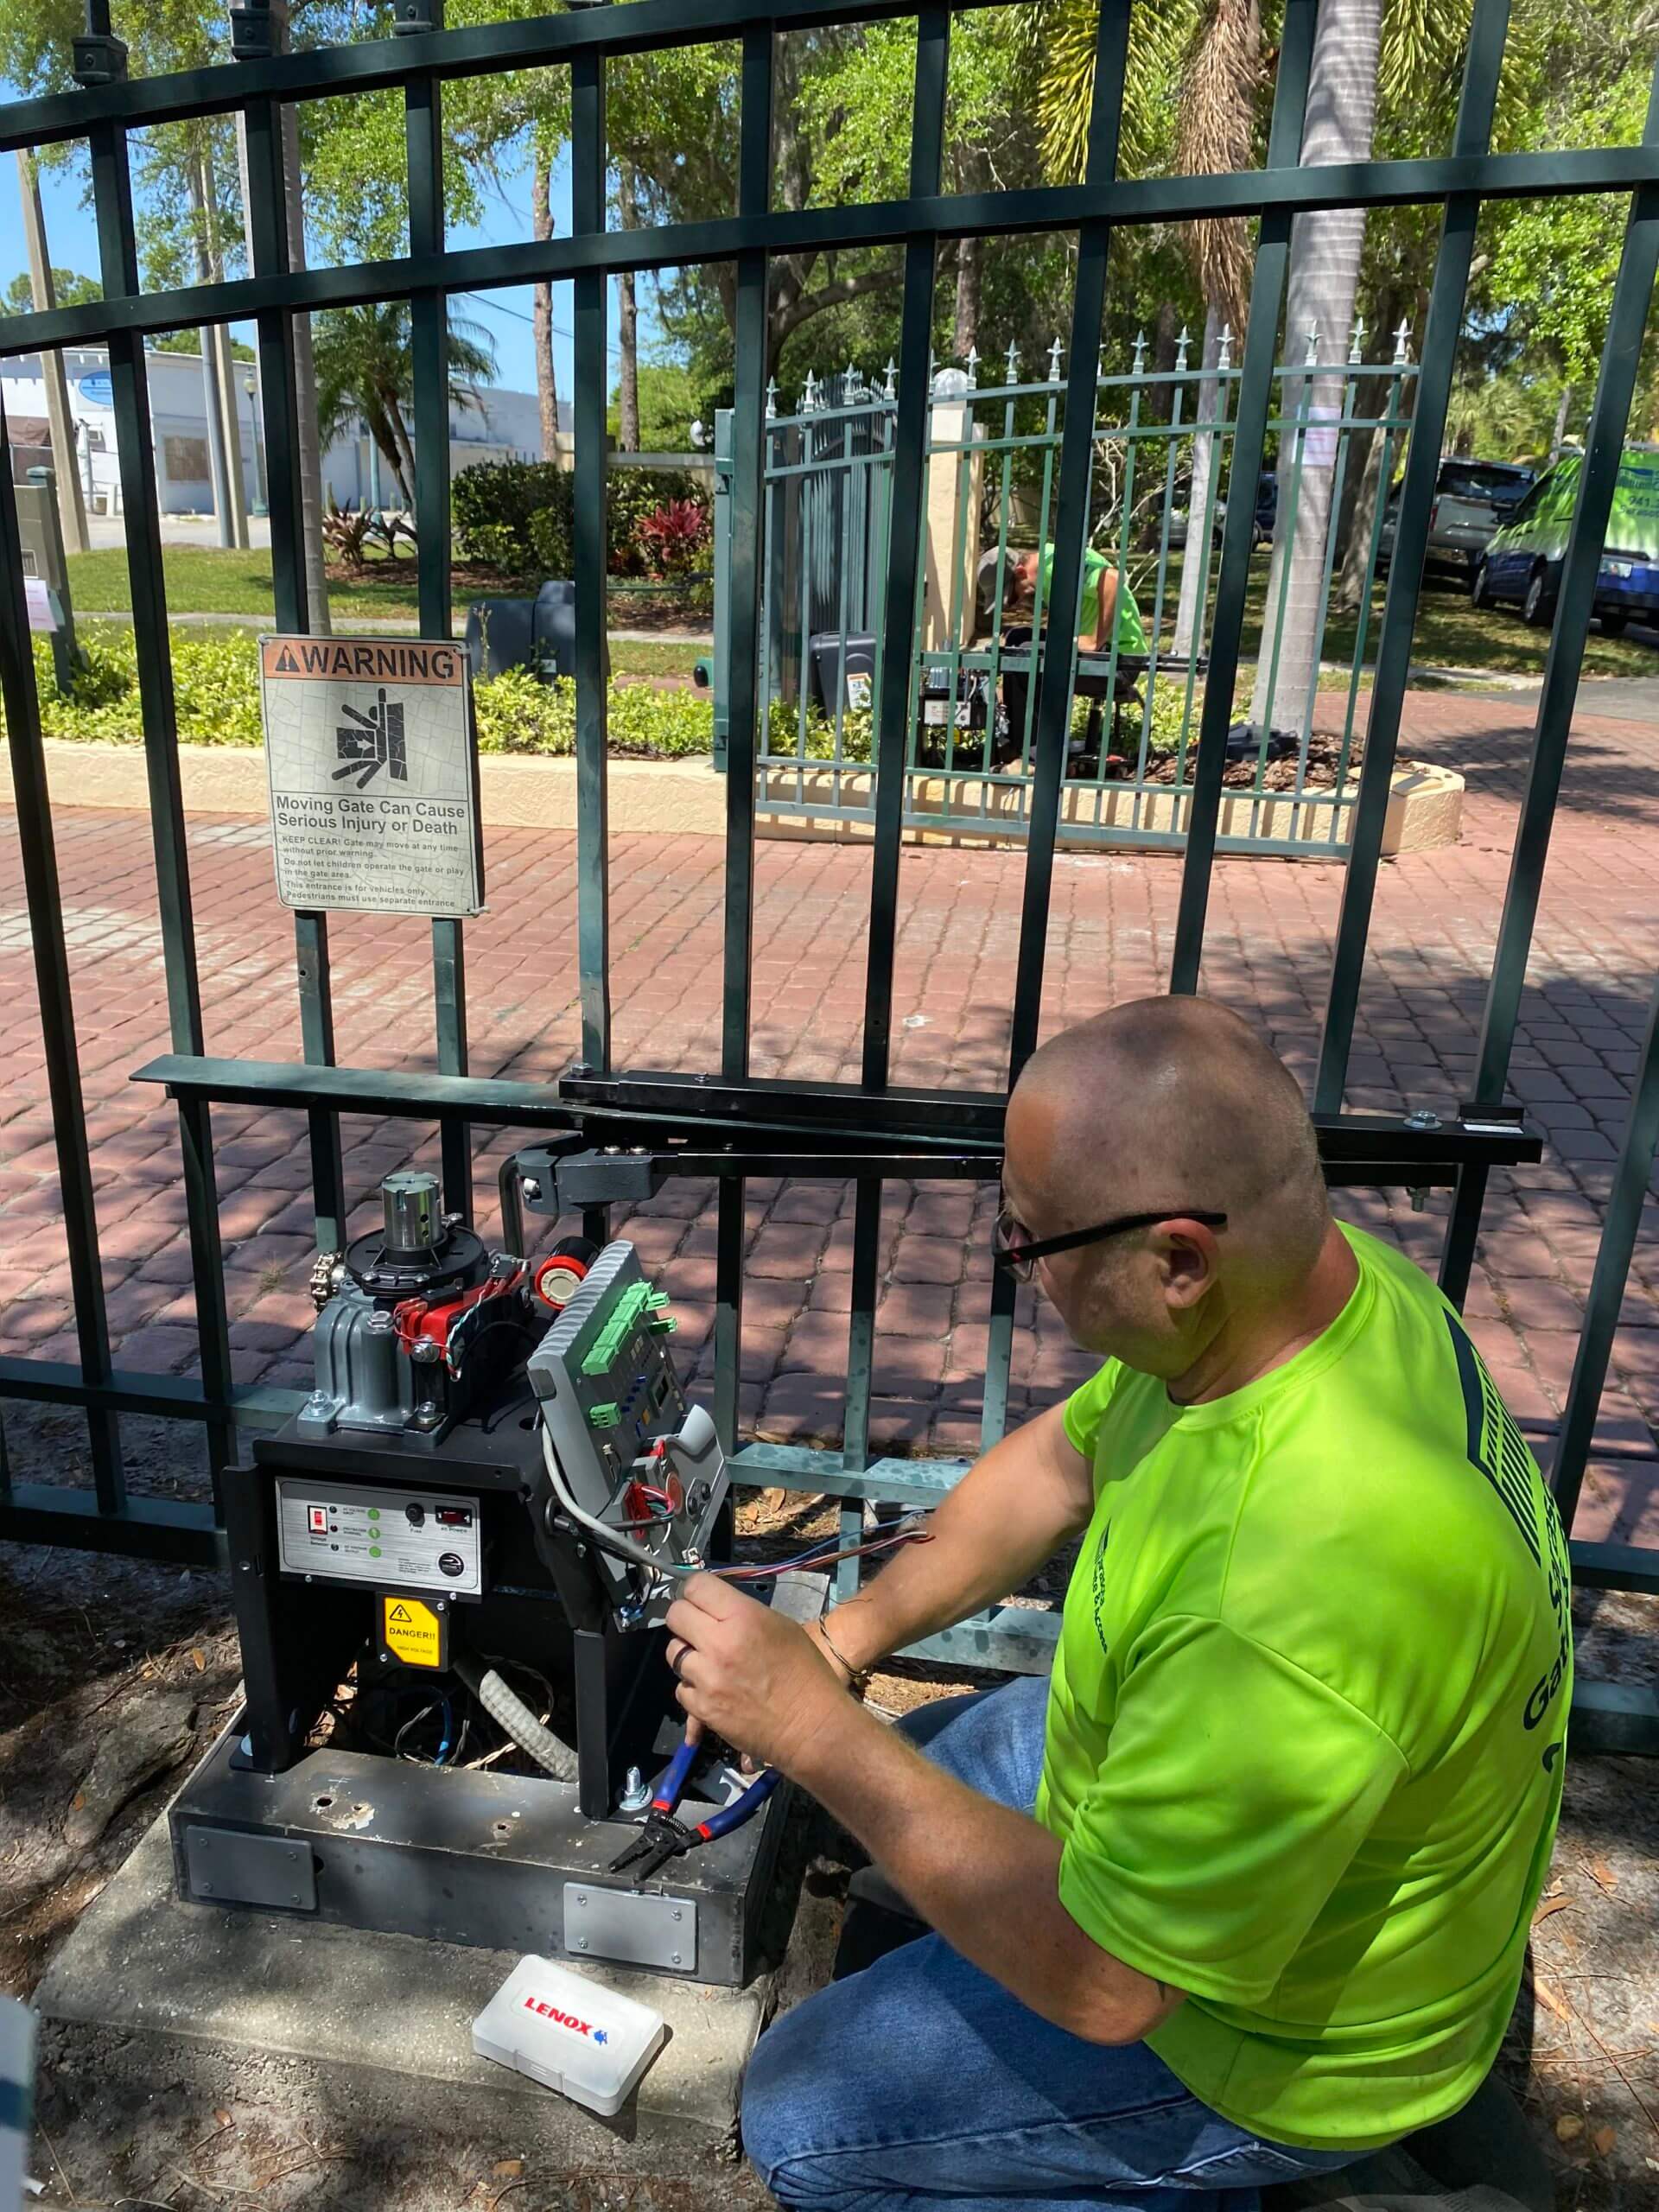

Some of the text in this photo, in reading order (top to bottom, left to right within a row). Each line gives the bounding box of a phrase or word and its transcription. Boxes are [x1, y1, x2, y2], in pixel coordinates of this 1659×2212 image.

[301, 645, 454, 679] WARNING
[276, 796, 465, 818] Moving Gate Can Cause
[278, 813, 457, 835] Serious Injury or Death
[327, 860, 361, 868] children
[447, 868, 464, 876] play
[287, 891, 336, 899] Pedestrians
[369, 886, 404, 894] vehicles
[523, 1997, 594, 2037] LENOX
